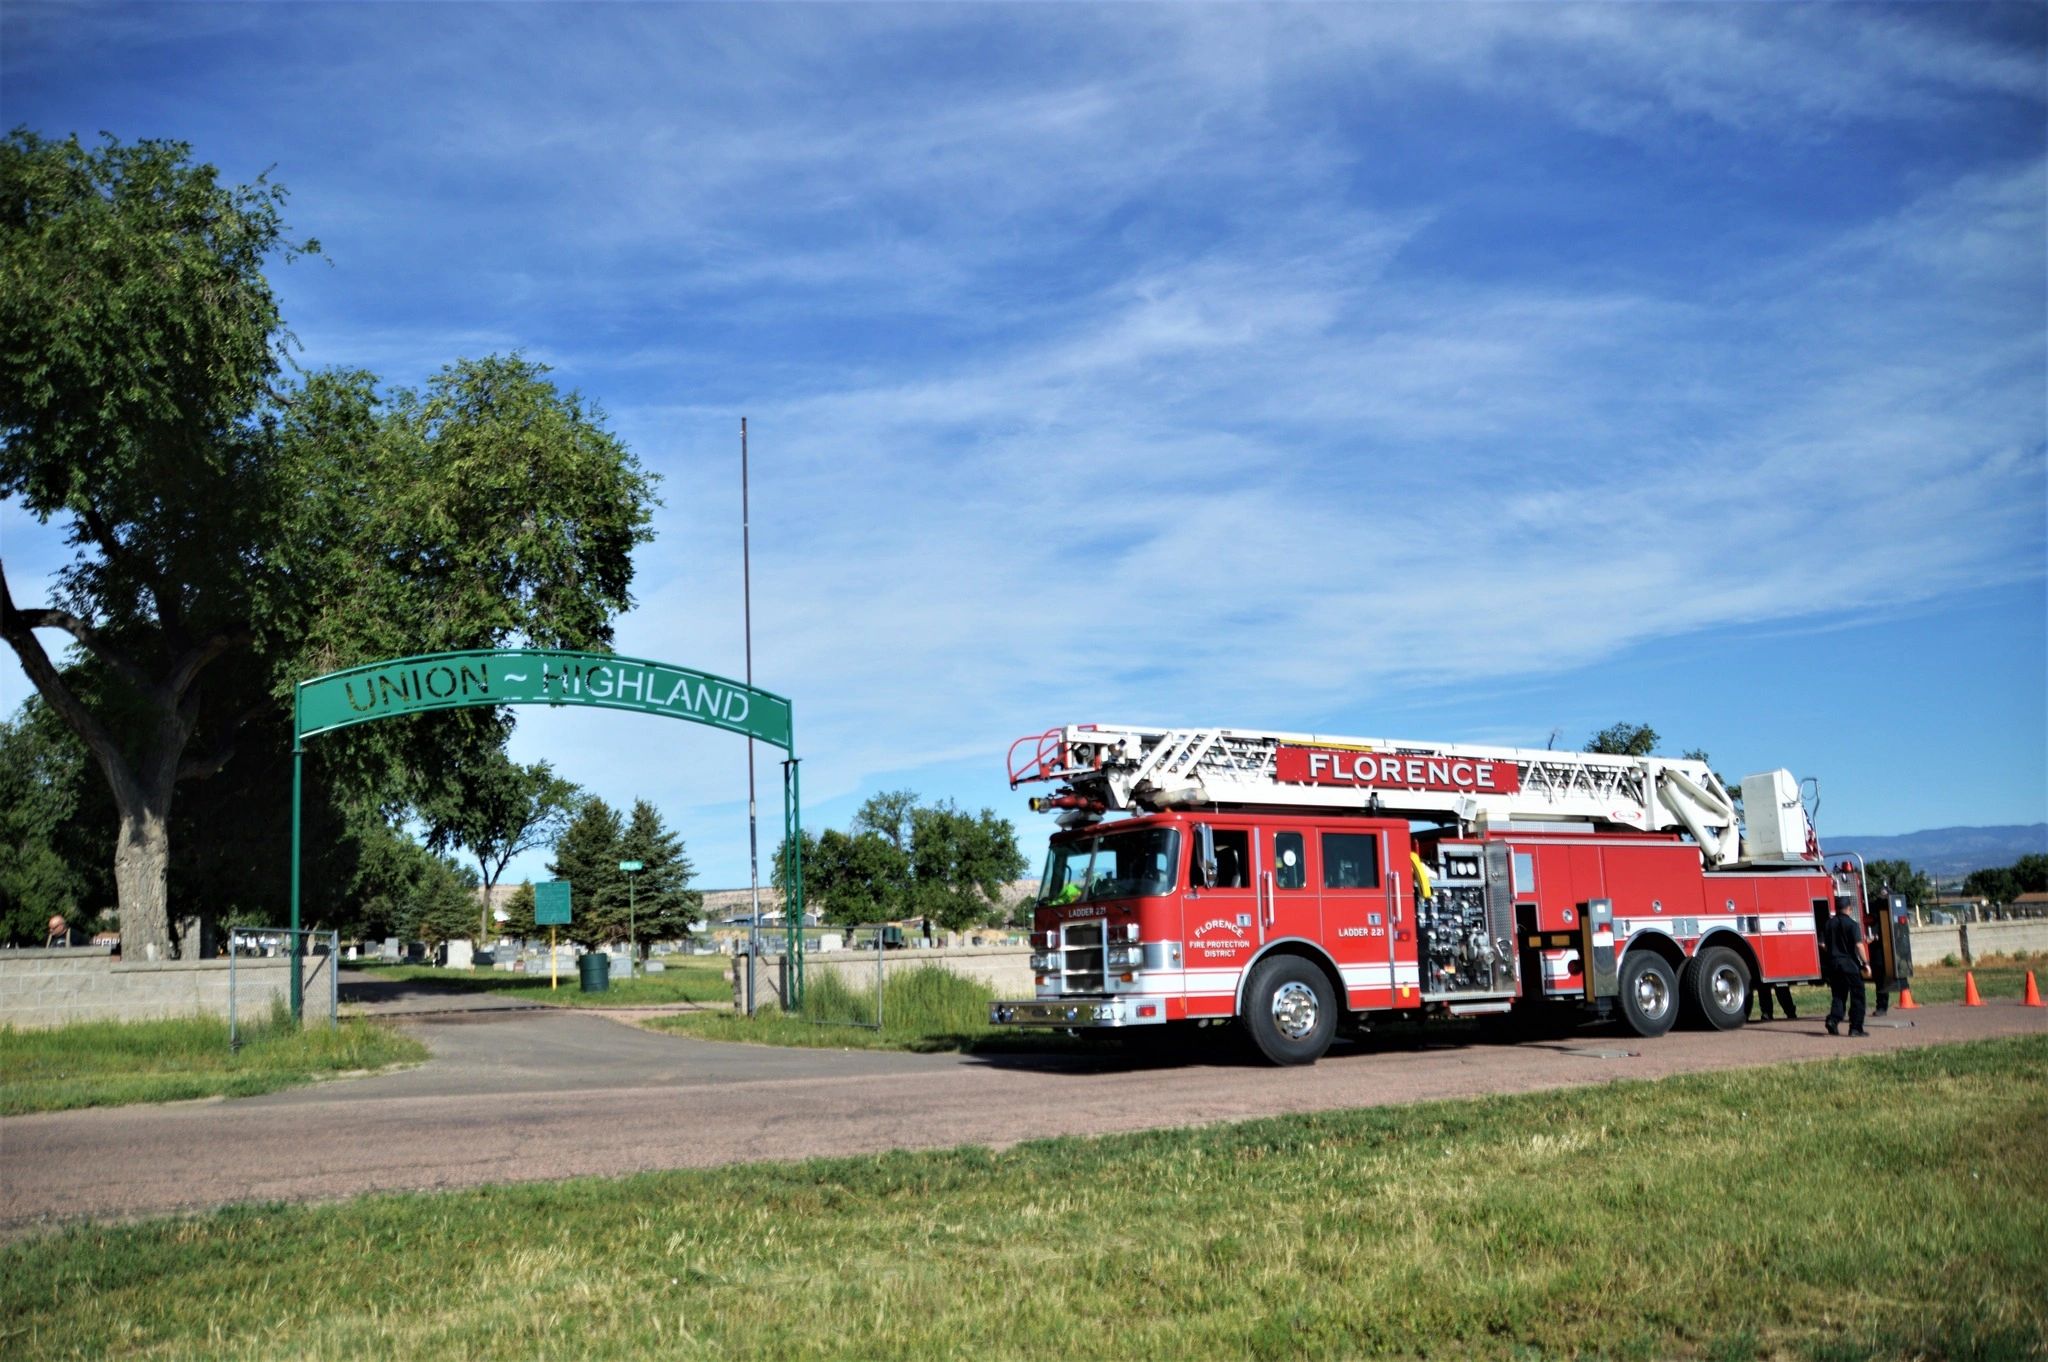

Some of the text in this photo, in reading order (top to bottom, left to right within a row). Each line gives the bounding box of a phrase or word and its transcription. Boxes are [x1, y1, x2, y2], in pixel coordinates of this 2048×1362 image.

[344, 663, 489, 712] UNION
[543, 662, 749, 722] HIGHLAND
[1309, 753, 1495, 788] FLORENCE
[1068, 907, 1094, 918] LADDER
[1194, 919, 1244, 939] FLORENCE
[1338, 927, 1384, 937] LADDER 221
[1189, 940, 1250, 948] FIRE PROTECTION
[1204, 949, 1236, 958] DISTRICT
